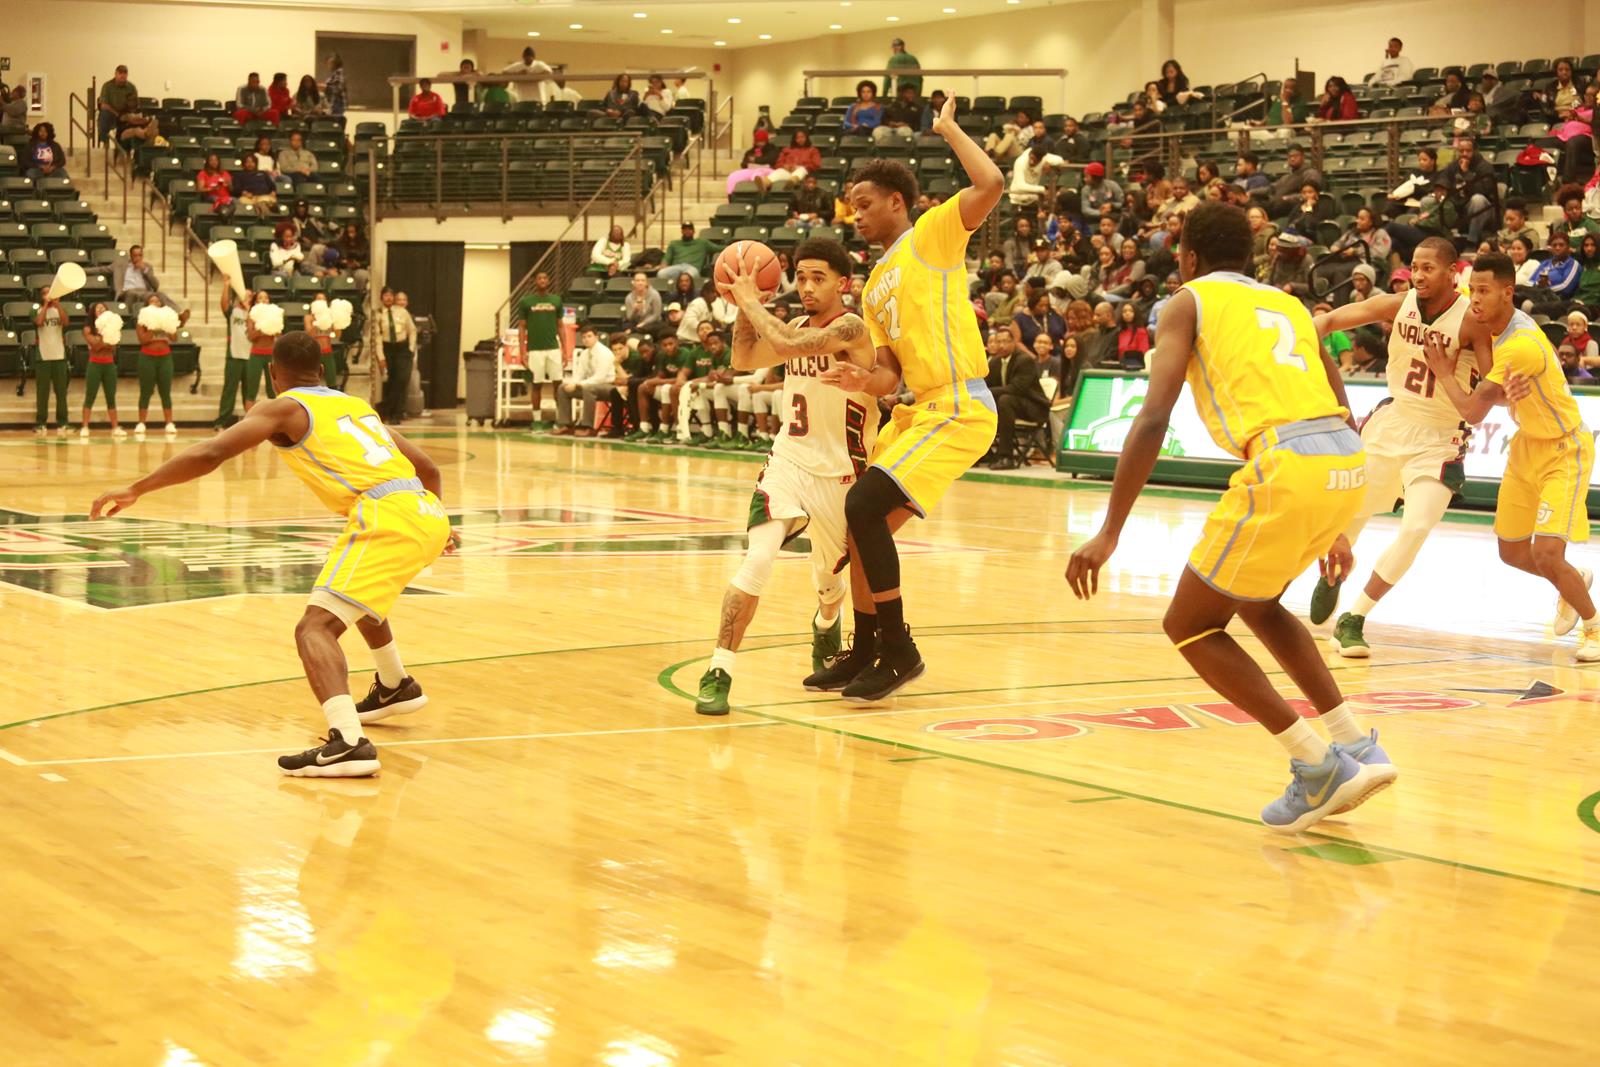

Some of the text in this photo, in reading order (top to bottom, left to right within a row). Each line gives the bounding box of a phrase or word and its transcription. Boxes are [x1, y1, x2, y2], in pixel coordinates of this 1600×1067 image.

[1254, 307, 1308, 372] 2
[1404, 357, 1437, 399] 21
[788, 393, 809, 437] 3
[1324, 464, 1368, 491] JAG
